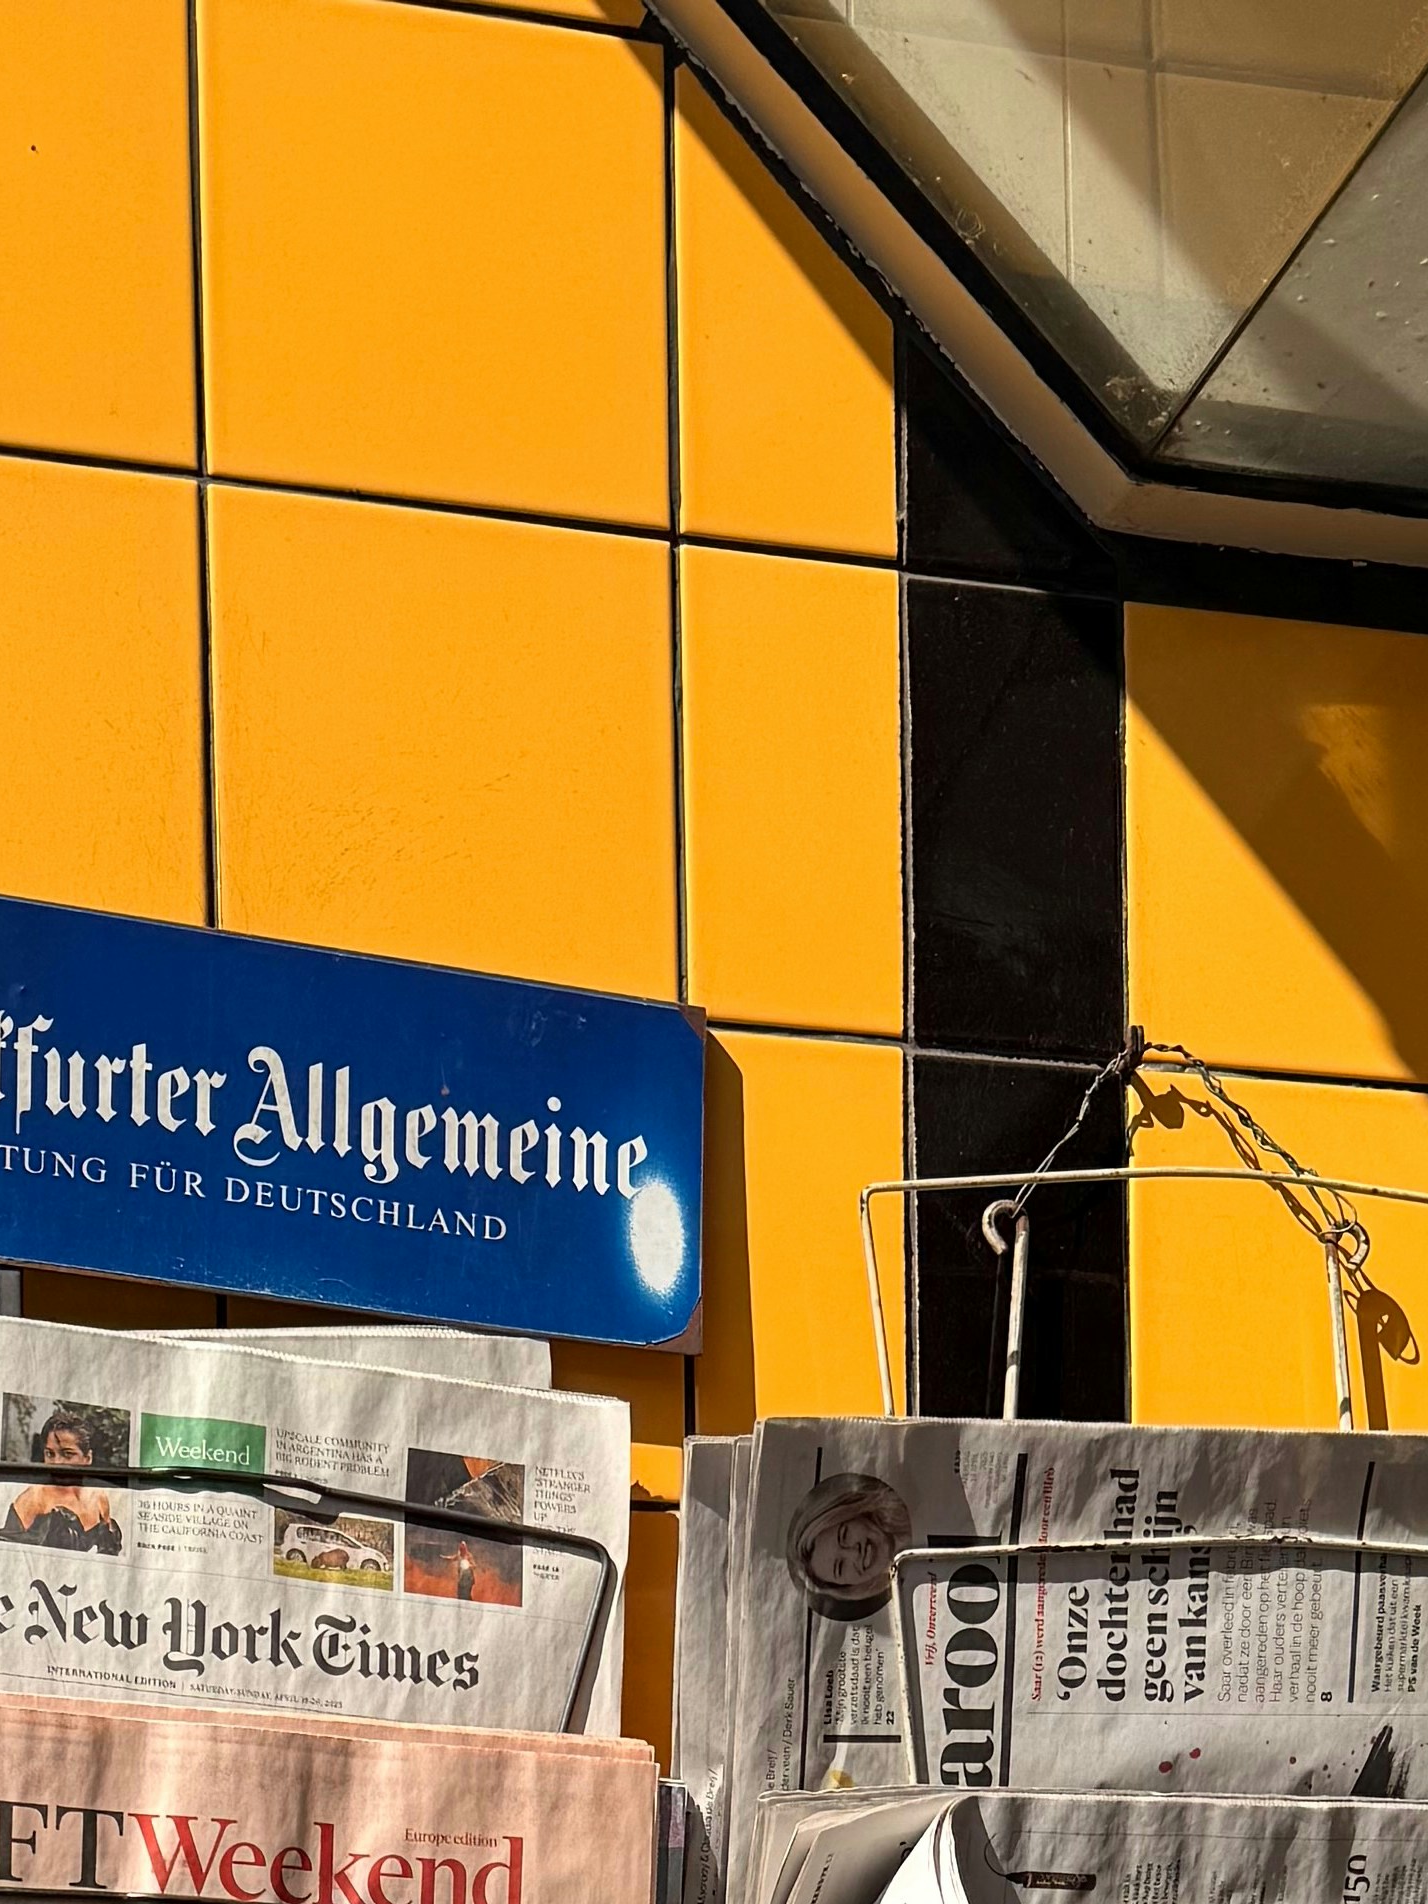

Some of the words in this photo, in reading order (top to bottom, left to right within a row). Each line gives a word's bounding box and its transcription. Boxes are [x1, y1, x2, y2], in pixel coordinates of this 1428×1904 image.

[233, 1045, 647, 1200] Allgemeine
[130, 1162, 204, 1198] FÜR
[224, 1176, 509, 1241] DEUTSCHLAND
[155, 1436, 251, 1467] Weekend
[1104, 1468, 1140, 1541] had
[25, 1579, 147, 1650] New
[162, 1598, 302, 1676] York
[313, 1615, 480, 1691] Times
[1097, 1549, 1130, 1702] dochter
[1143, 1606, 1174, 1703] geen
[1220, 1602, 1236, 1666] overleed
[1254, 1614, 1272, 1703] aangereden
[1184, 1635, 1208, 1703] van
[1218, 1671, 1232, 1702] Saar
[404, 1828, 452, 1847] Europe
[452, 1831, 498, 1848] edition
[1342, 1853, 1370, 1904] 150
